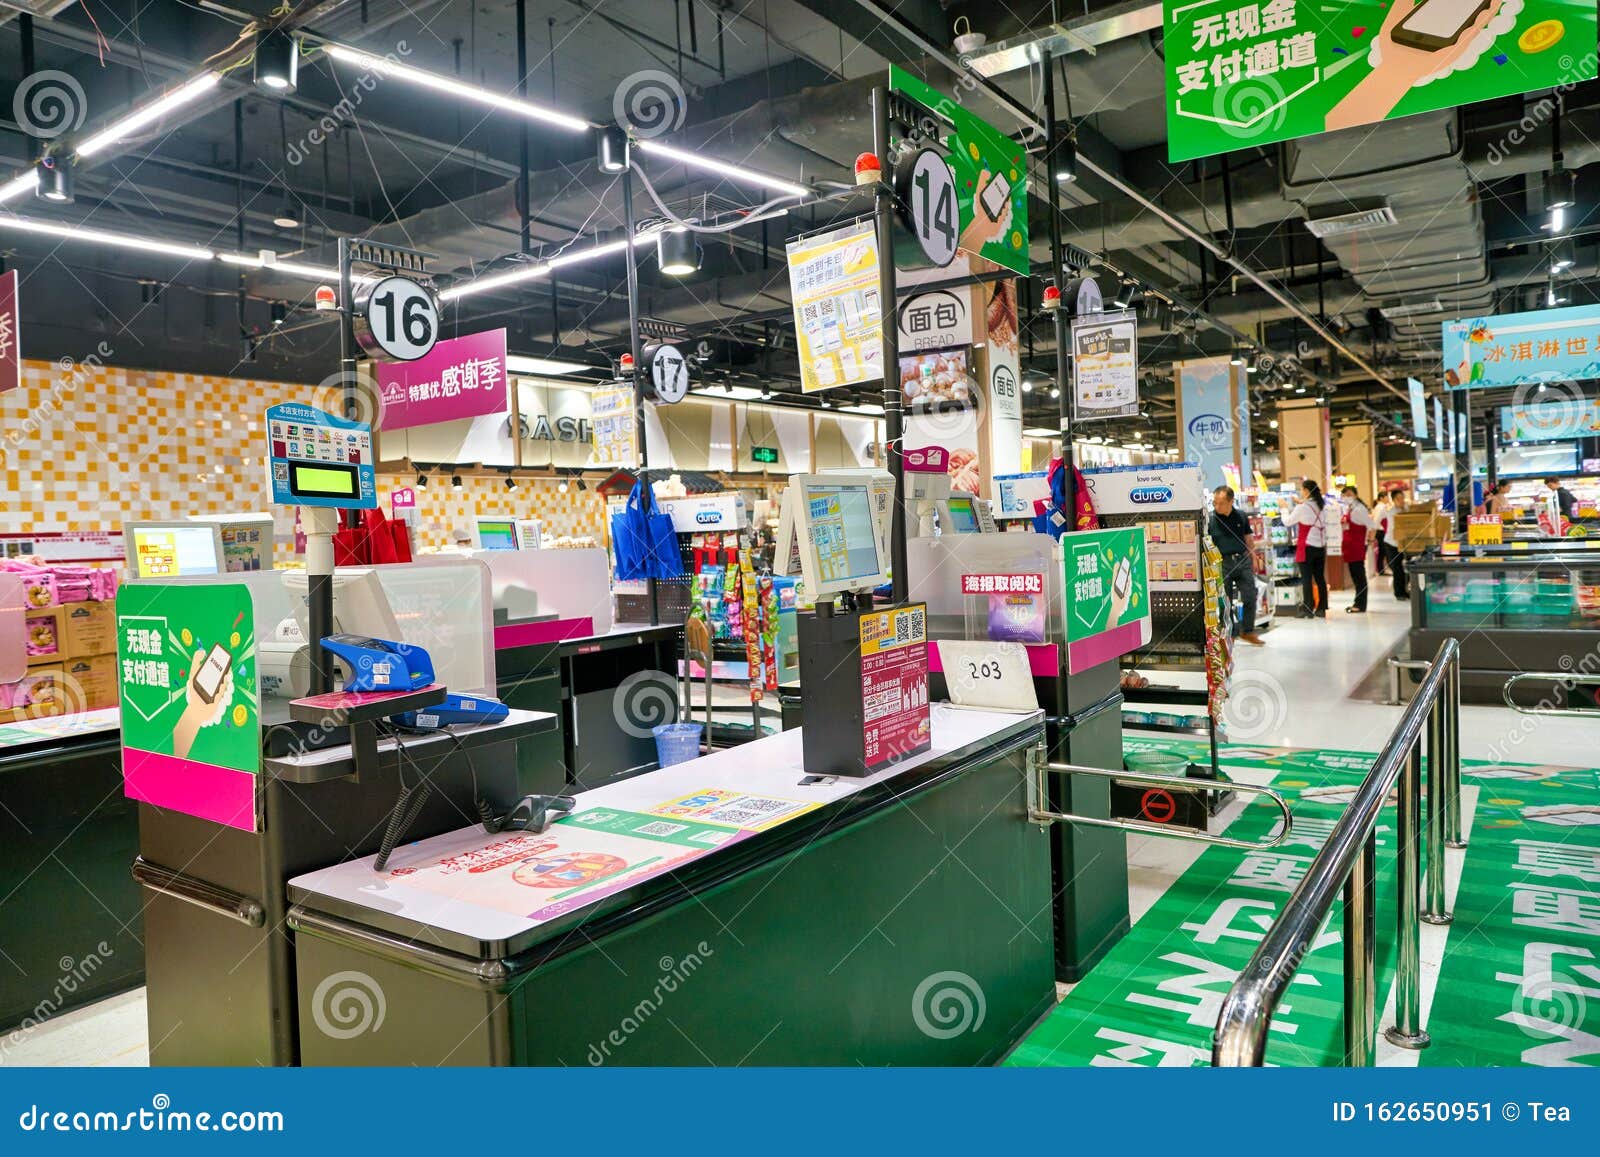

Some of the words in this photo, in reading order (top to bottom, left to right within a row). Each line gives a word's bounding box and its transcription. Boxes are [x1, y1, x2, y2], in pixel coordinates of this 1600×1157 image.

[1191, 0, 1298, 52] 无现金
[1175, 32, 1318, 96] 支付通道
[911, 168, 955, 252] 14
[375, 290, 433, 347] 16
[908, 303, 958, 333] 面包
[914, 333, 956, 350] BREAD
[1483, 337, 1600, 363] 冰淇淋世
[654, 355, 684, 393] 17
[997, 375, 1015, 398] 面包
[1195, 420, 1225, 436] 牛奶
[1133, 489, 1169, 501] durex
[697, 514, 720, 523] durex
[1470, 516, 1501, 525] SALE
[965, 575, 1041, 592] 海报取阅处
[126, 628, 163, 655] 无现金
[122, 659, 170, 688] 支付通道
[968, 661, 1002, 680] 203
